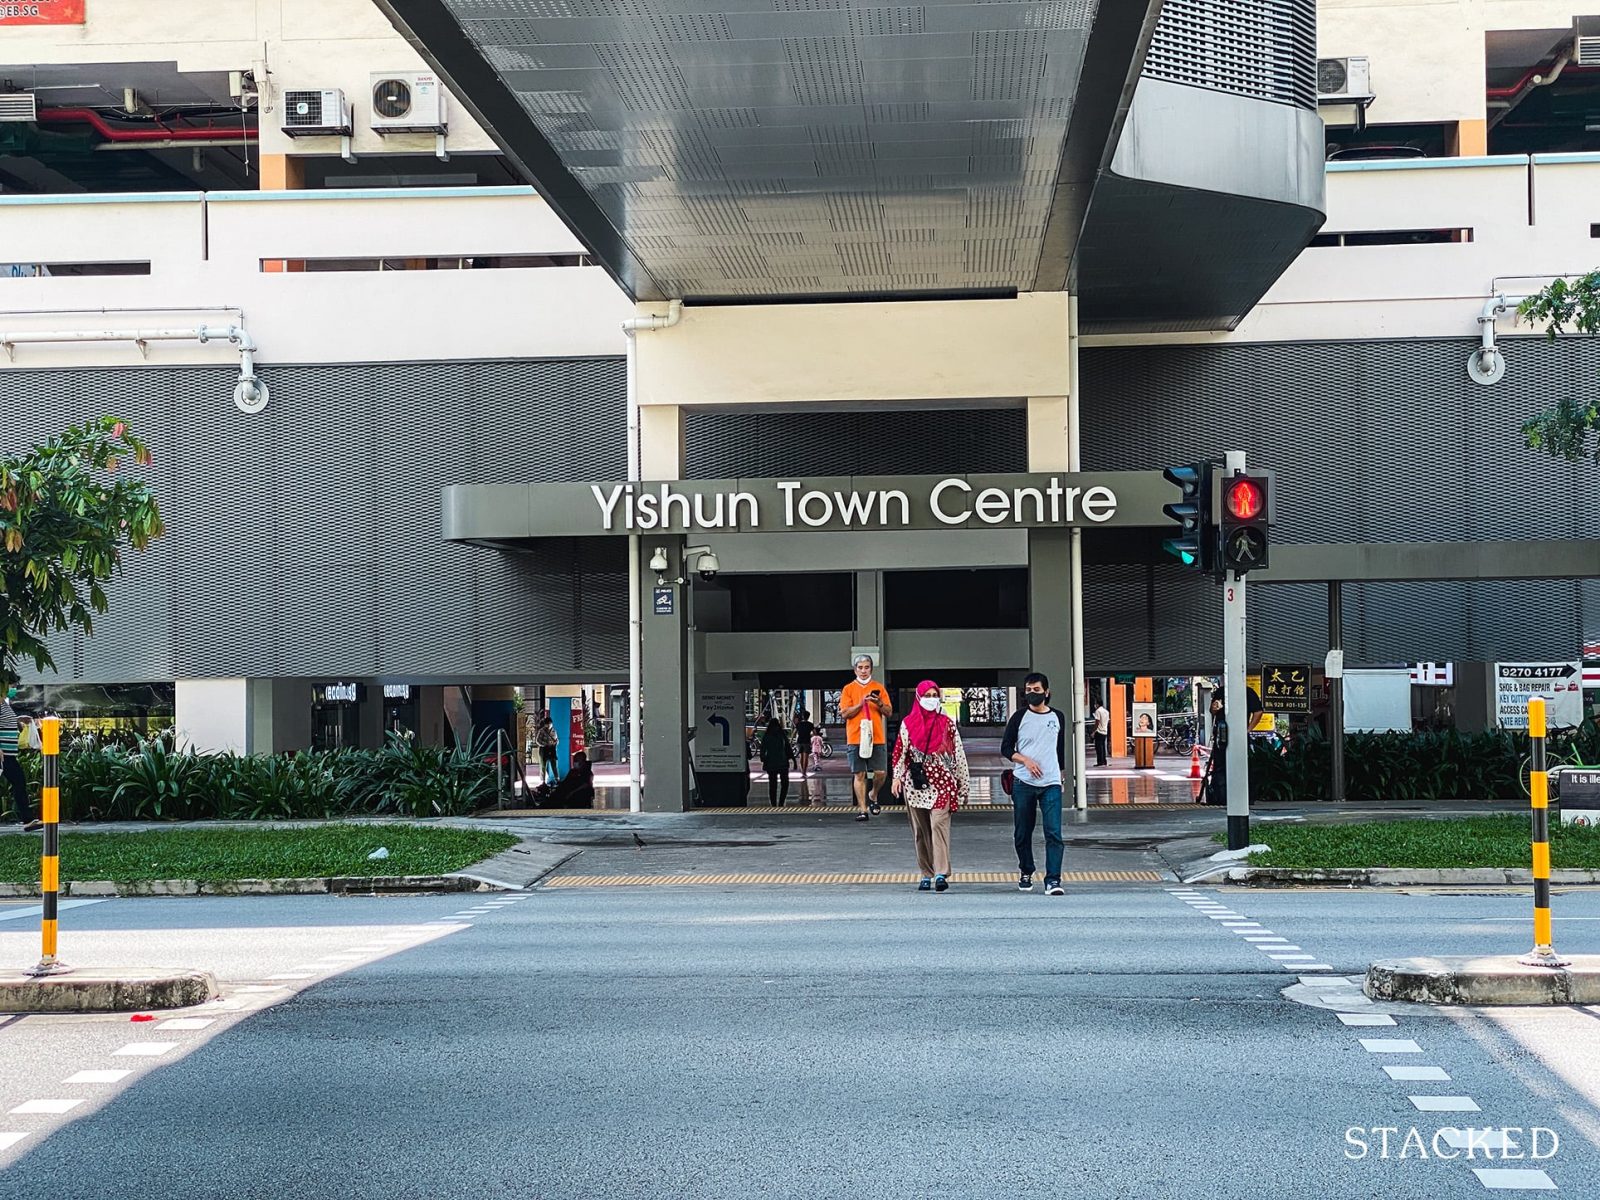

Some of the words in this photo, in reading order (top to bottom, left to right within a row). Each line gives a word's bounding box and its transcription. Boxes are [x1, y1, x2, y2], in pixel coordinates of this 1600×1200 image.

[591, 484, 759, 530] Yishun
[777, 480, 910, 527] Town
[929, 476, 1118, 525] Centre
[1227, 588, 1234, 602] 3
[1502, 667, 1532, 677] 9270
[1534, 667, 1563, 677] 4177
[1499, 682, 1513, 692] SHOE
[1514, 683, 1518, 692] &
[1519, 682, 1530, 692] BAG
[1531, 682, 1551, 692] REPAIR
[1500, 694, 1510, 703] KEY
[1500, 705, 1520, 715] ACCESS
[1521, 705, 1529, 715] CA
[1571, 774, 1578, 783] It
[1579, 774, 1587, 784] is
